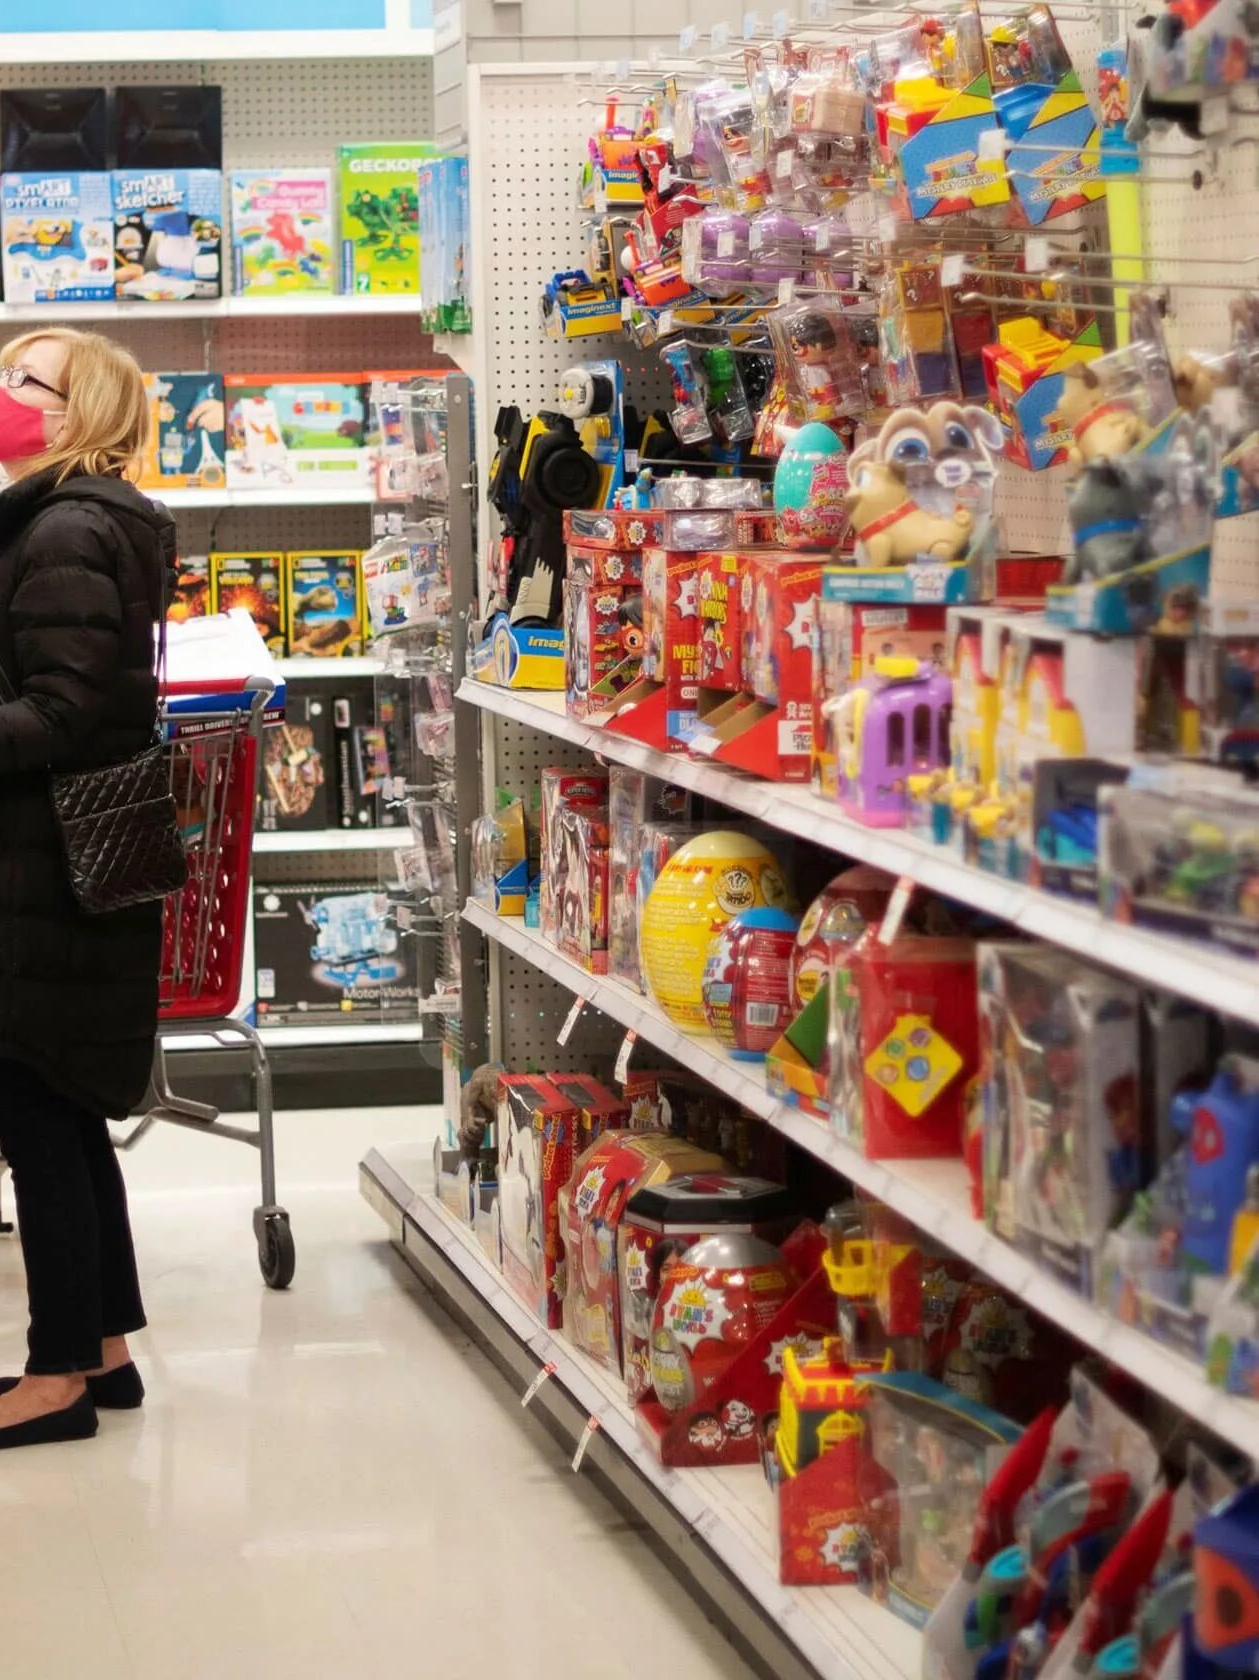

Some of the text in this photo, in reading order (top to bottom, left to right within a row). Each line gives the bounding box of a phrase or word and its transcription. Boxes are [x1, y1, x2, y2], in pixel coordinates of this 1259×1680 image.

[567, 302, 616, 317] imaginext
[181, 725, 203, 734] THRILL
[343, 986, 380, 999] Motor
